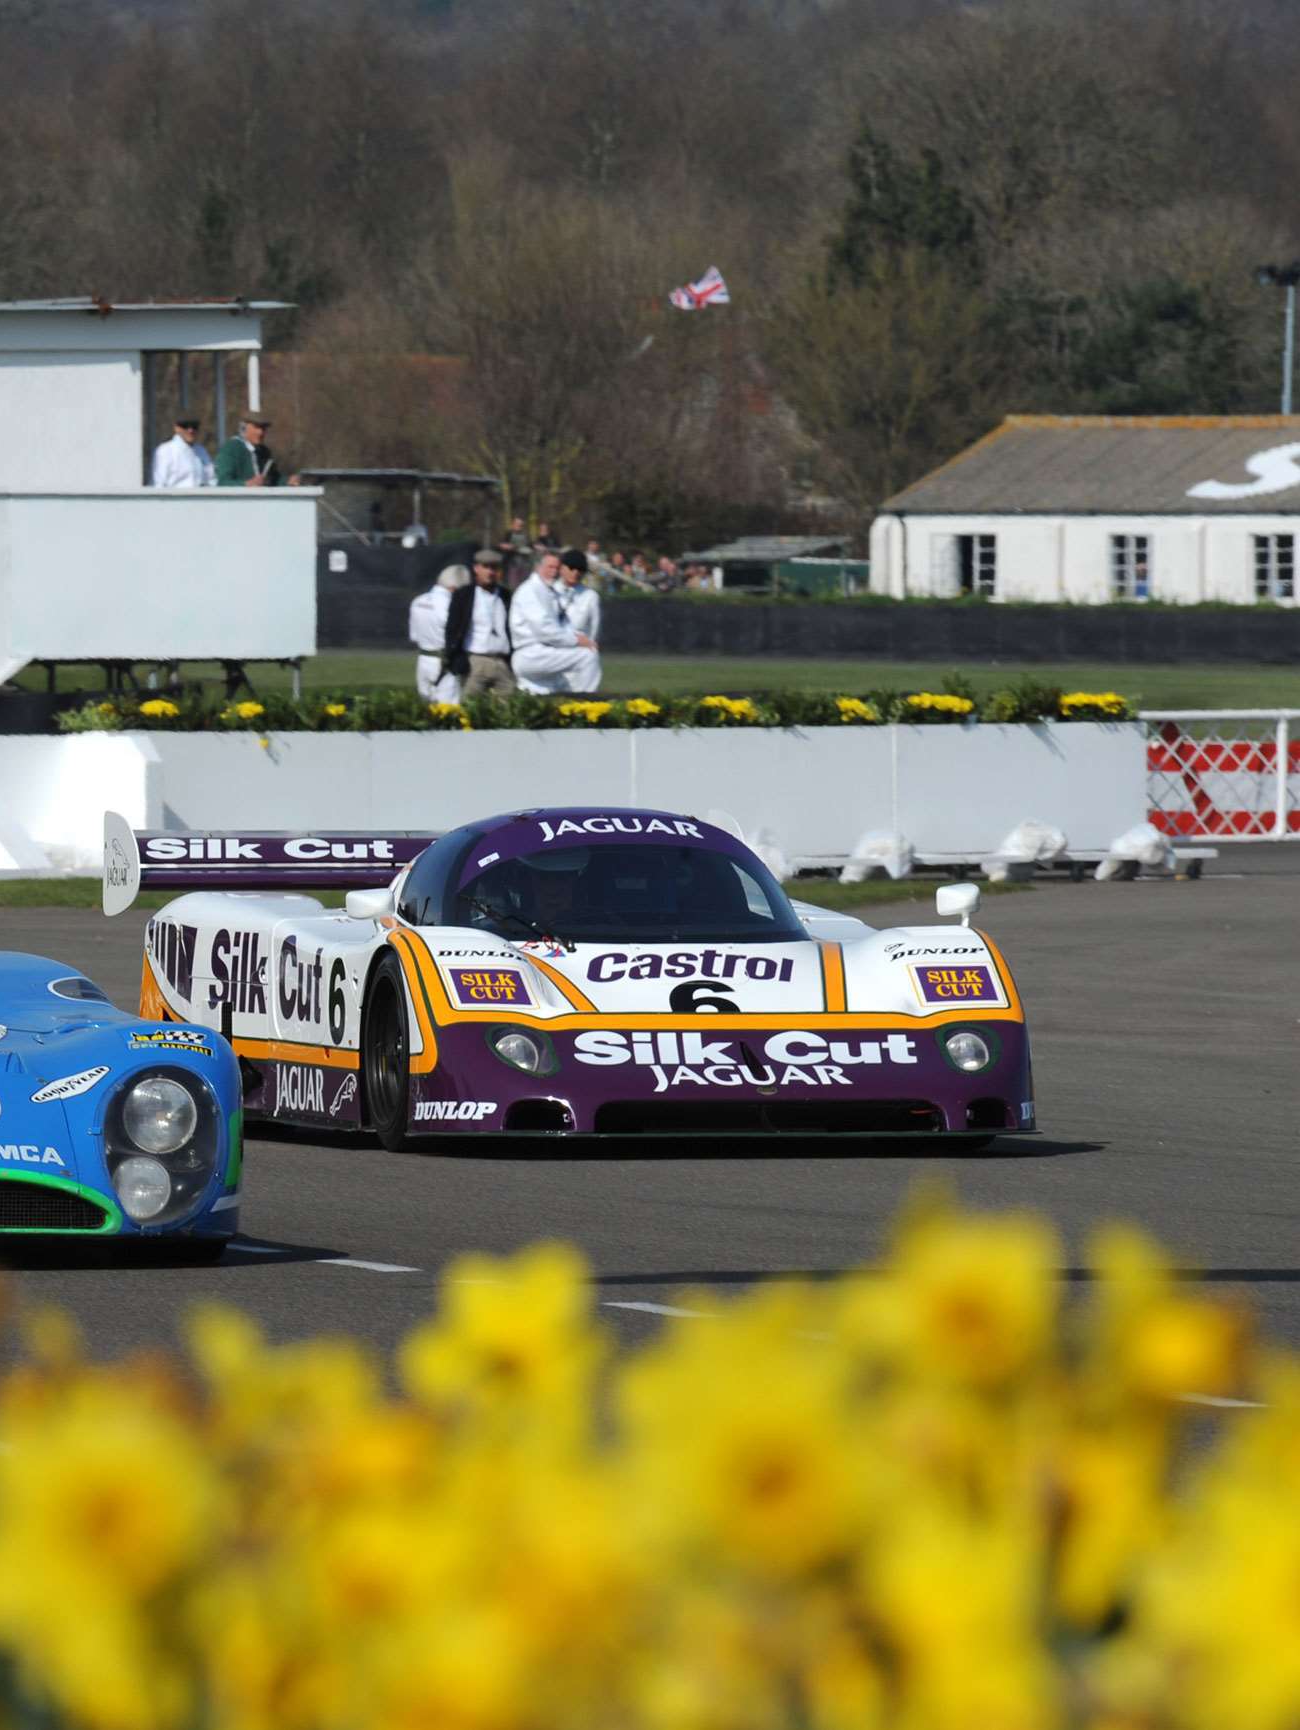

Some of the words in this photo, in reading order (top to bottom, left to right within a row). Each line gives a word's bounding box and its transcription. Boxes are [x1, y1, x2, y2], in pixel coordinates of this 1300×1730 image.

[538, 817, 704, 842] JAGUAR
[146, 838, 262, 860] Silk
[284, 838, 395, 859] Cut
[891, 946, 985, 962] DUNLOP
[586, 949, 794, 983] Castrol
[926, 969, 984, 983] SILK
[208, 929, 269, 1015] Silk
[279, 935, 324, 1025] Cut
[328, 957, 347, 1046] 6
[460, 972, 517, 987] SILK
[935, 983, 983, 997] CUT
[470, 986, 516, 1001] CUT
[669, 980, 742, 1013] 6
[160, 1042, 211, 1057] MARCHAL
[573, 1030, 734, 1066] Silk
[764, 1030, 918, 1065] Cut
[650, 1064, 853, 1093] JAGUAR
[273, 1063, 326, 1118] JAGUAR
[414, 1101, 498, 1121] DUNLOP
